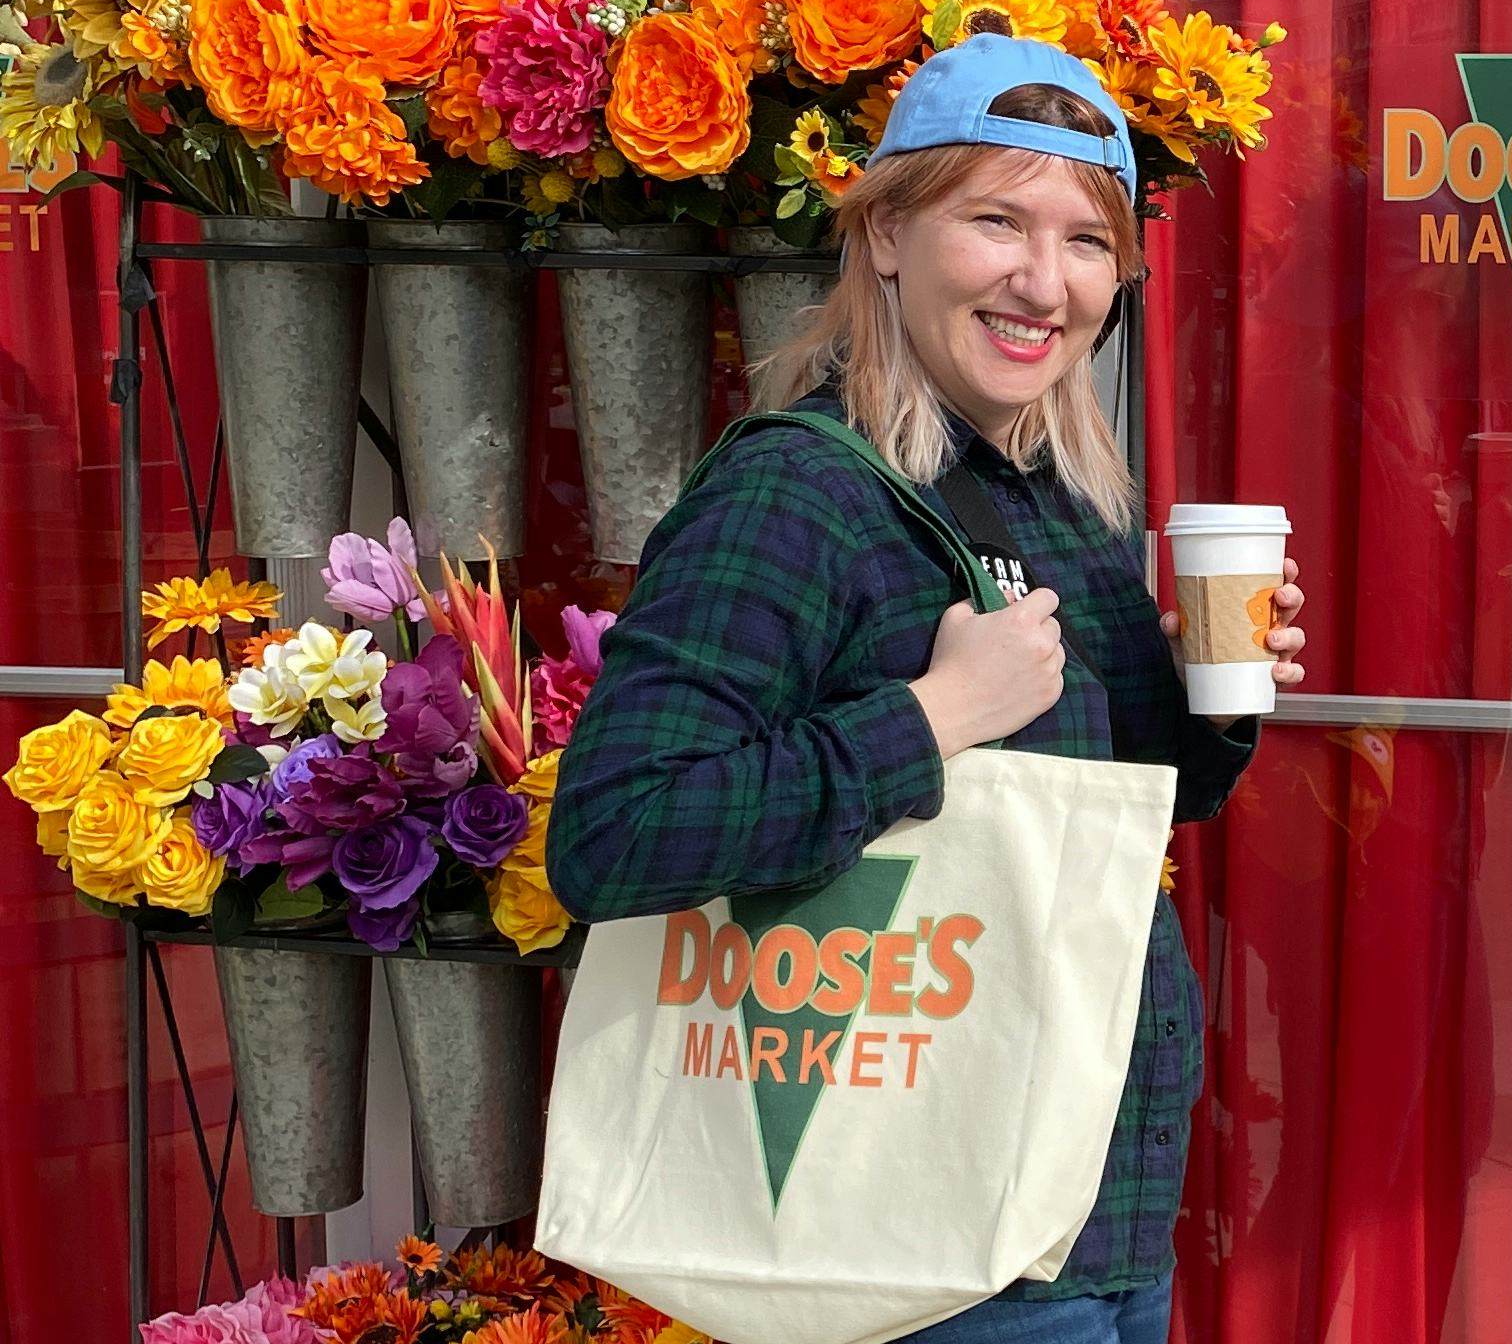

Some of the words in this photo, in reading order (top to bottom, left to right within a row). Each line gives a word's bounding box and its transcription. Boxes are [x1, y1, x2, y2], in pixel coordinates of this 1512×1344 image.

[980, 555, 1025, 582] EAM
[656, 908, 987, 1020] DOOSE'S
[682, 1022, 933, 1089] MARKET
